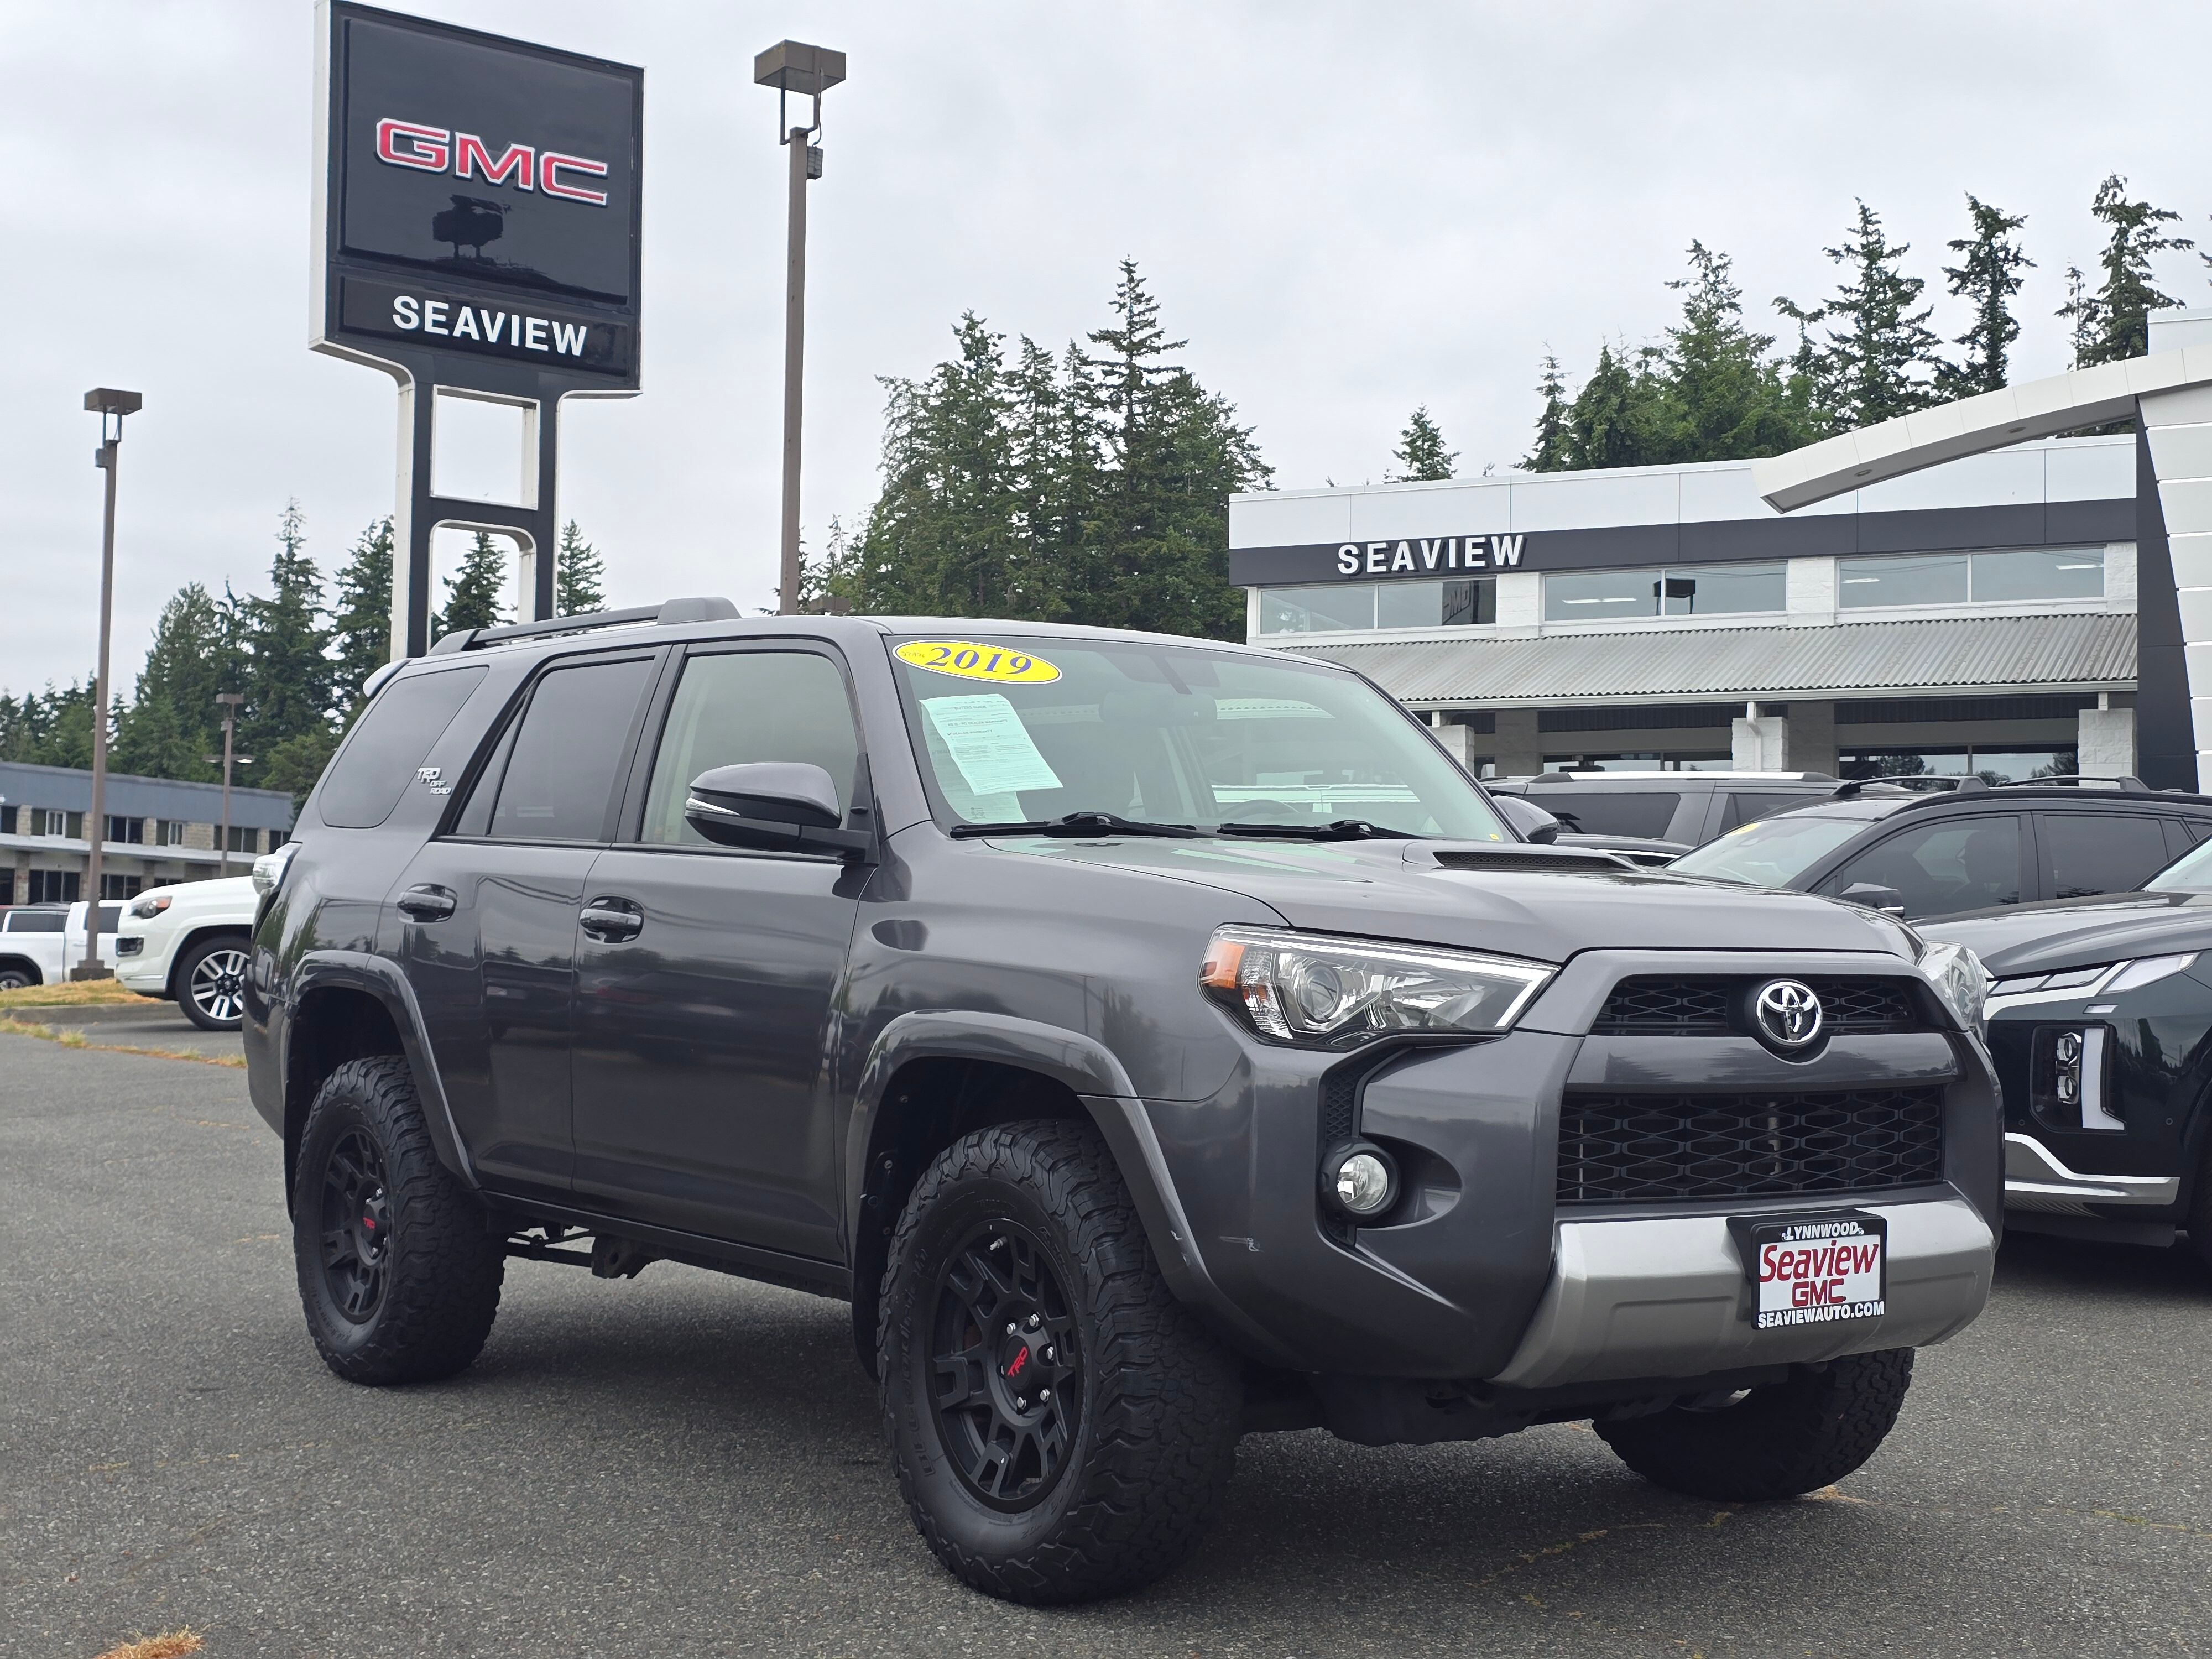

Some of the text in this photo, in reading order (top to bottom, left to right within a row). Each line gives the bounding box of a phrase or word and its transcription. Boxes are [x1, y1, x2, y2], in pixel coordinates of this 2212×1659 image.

[375, 117, 608, 206] GMC
[392, 295, 587, 357] SEAVIEW
[1337, 535, 1525, 575] SEAVIEW
[925, 646, 1032, 675] 2019
[417, 768, 441, 783] TRD
[1786, 1222, 1858, 1240] LYNNWOOD
[1760, 1240, 1879, 1282] Seaview
[1792, 1278, 1846, 1307] GMC
[1757, 1301, 1885, 1328] SEAVIEWAUTO.COM
[1007, 1347, 1029, 1378] TRD
